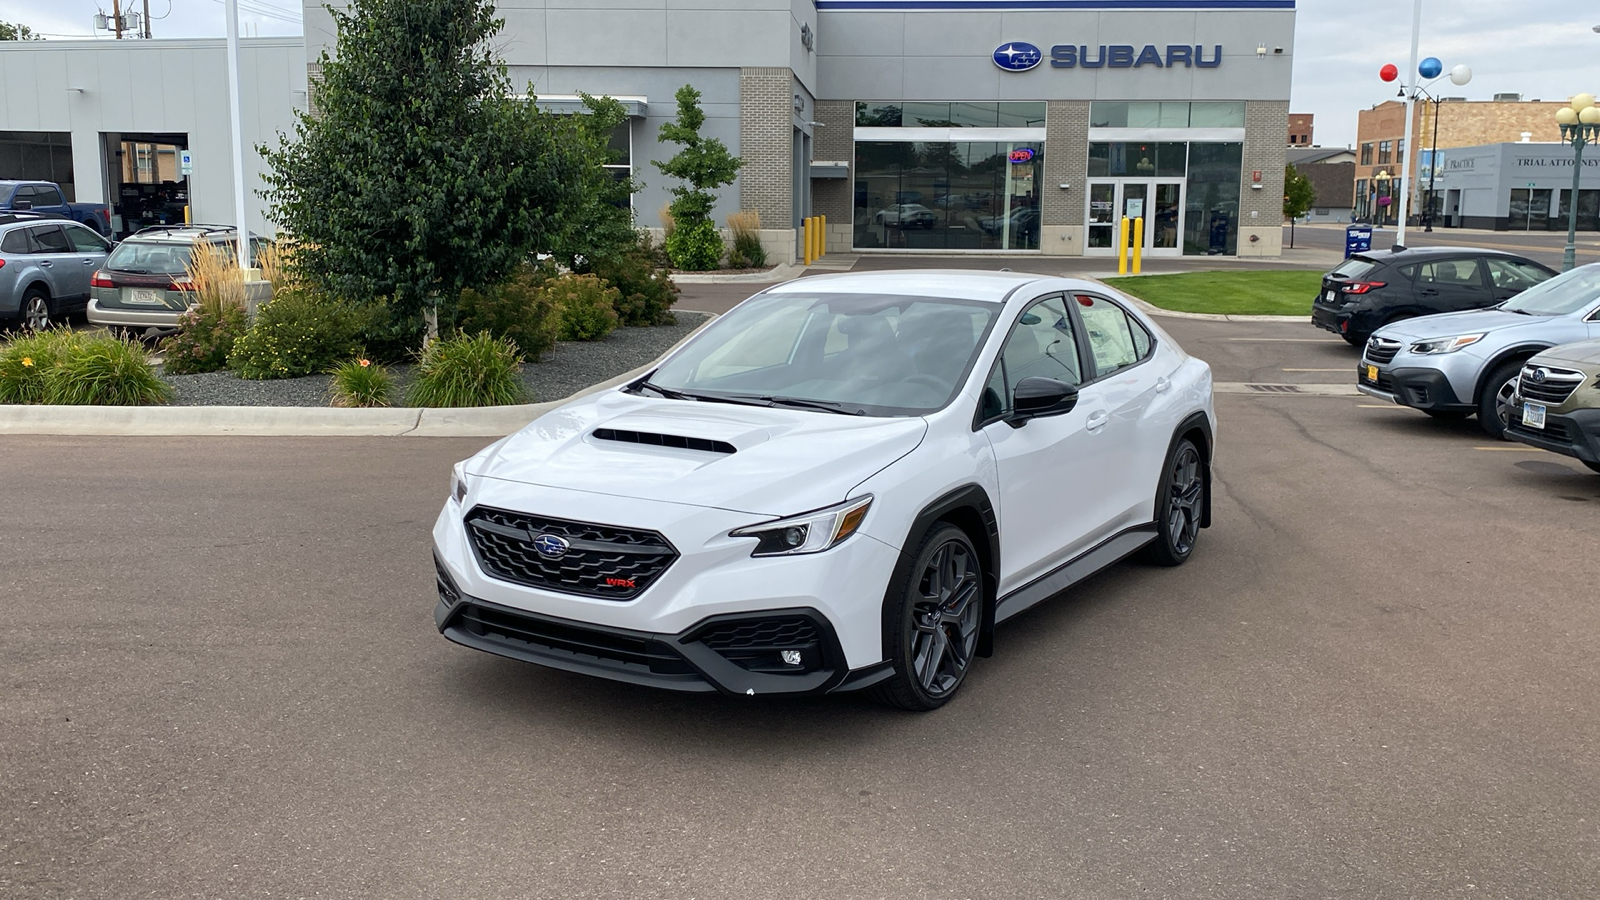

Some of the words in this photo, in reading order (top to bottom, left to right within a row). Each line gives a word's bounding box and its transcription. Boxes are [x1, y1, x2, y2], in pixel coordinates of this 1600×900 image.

[1050, 45, 1222, 68] SUBARU
[1010, 151, 1031, 160] OPEN
[1450, 158, 1475, 169] PRACTICE
[1517, 158, 1547, 167] TRIAL
[1549, 158, 1600, 167] ATTONEY
[606, 578, 636, 588] WRX
